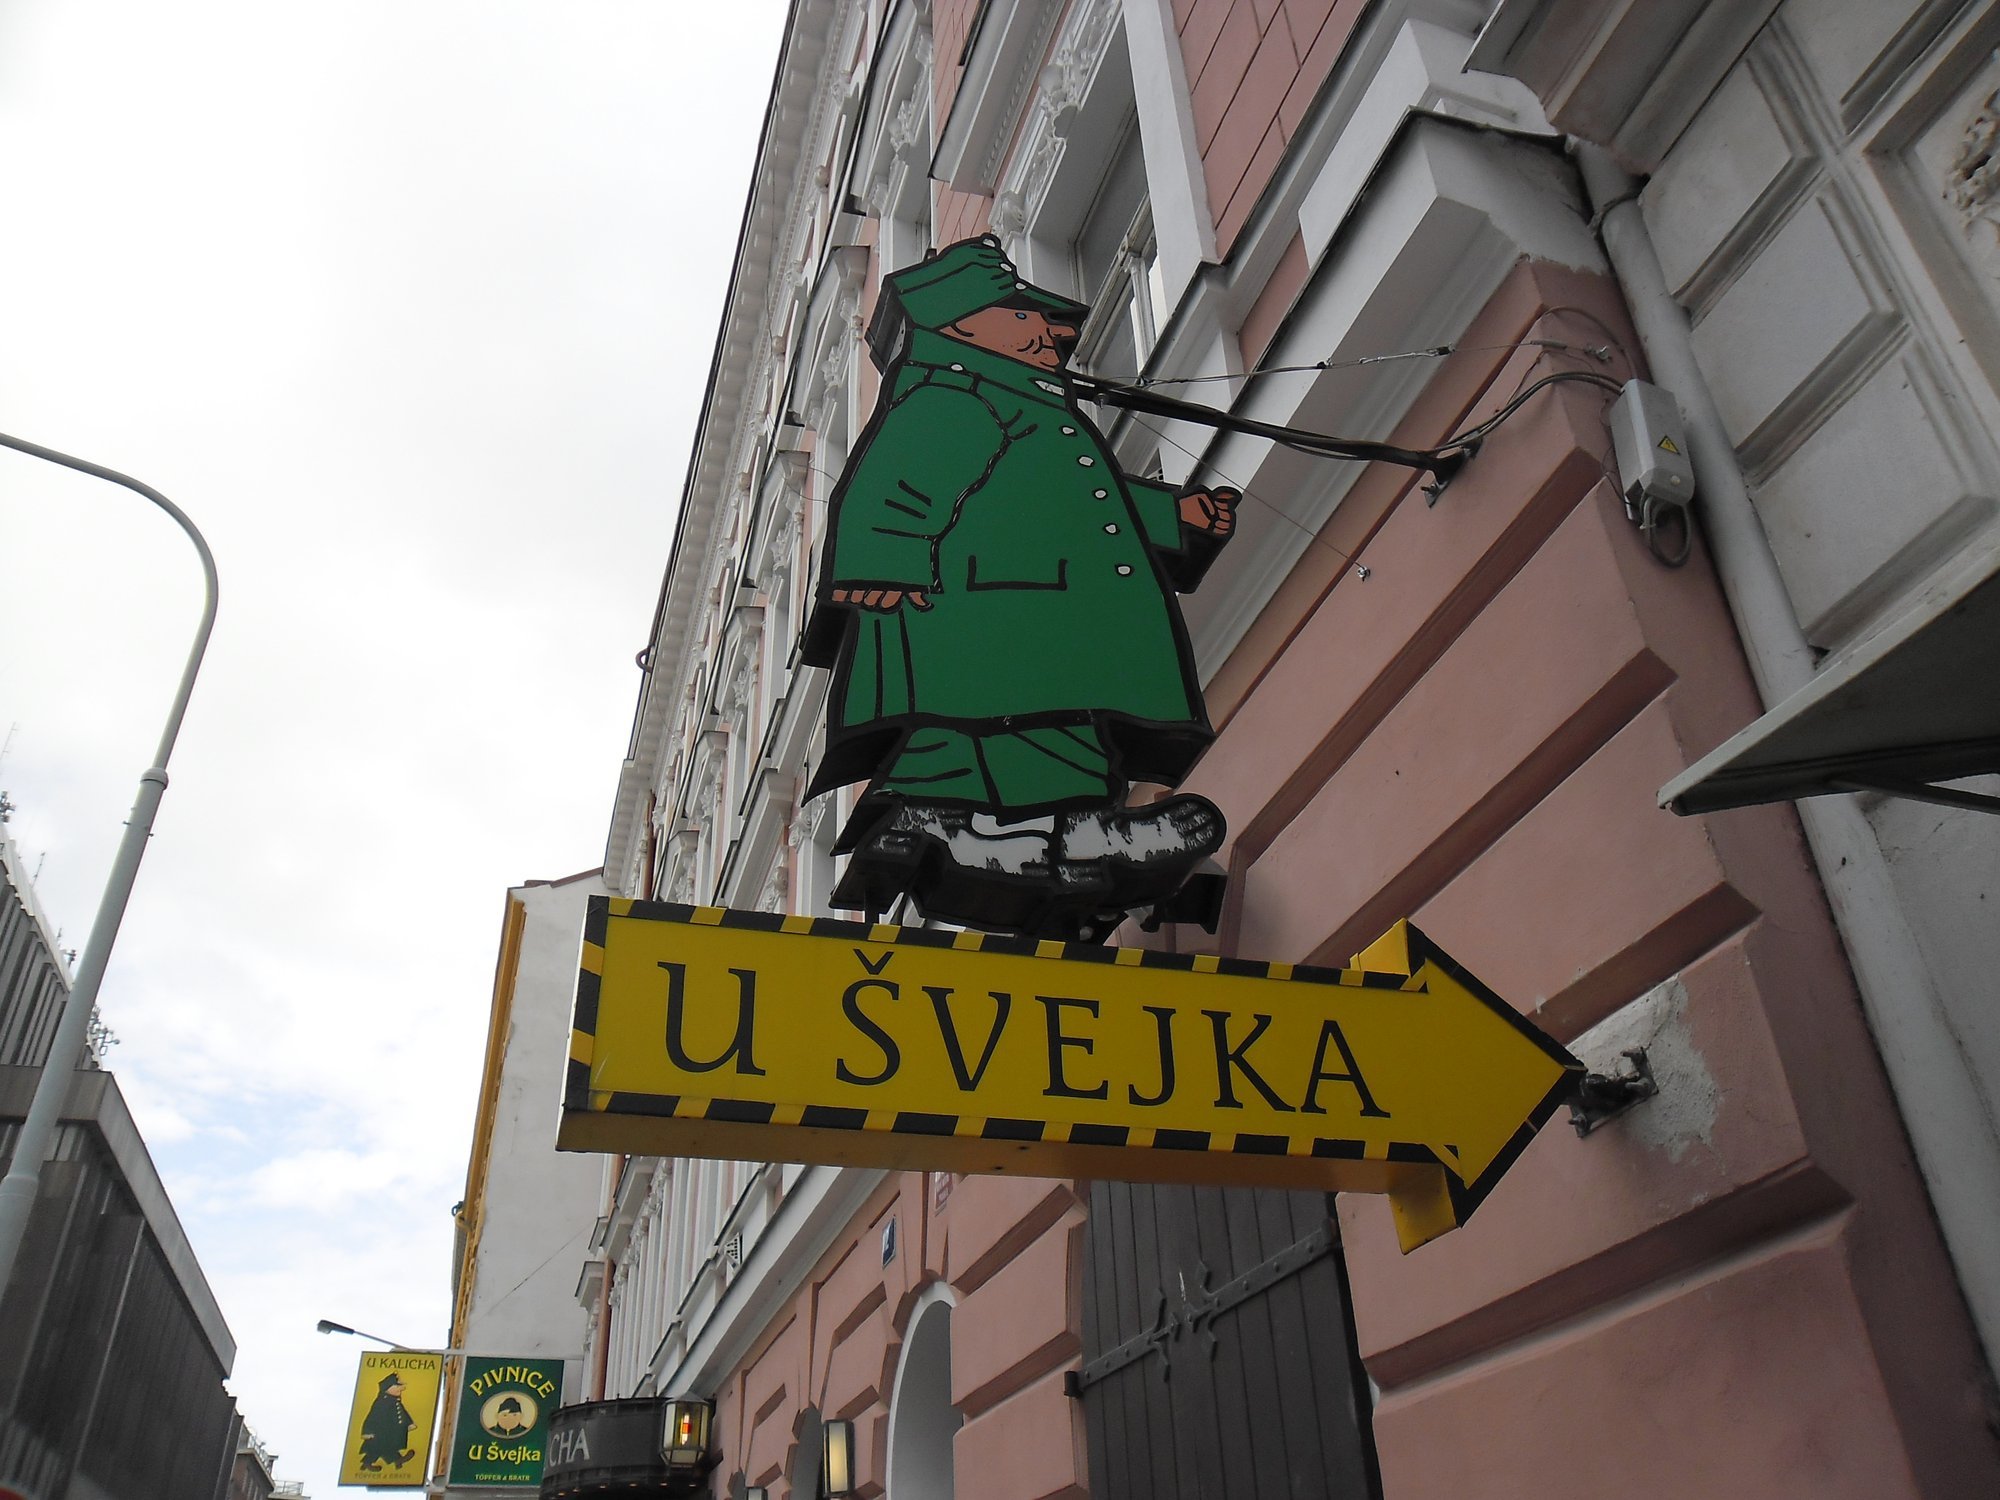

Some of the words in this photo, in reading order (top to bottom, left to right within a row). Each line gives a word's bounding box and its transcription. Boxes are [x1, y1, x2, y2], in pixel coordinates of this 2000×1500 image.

[657, 961, 766, 1077] U
[835, 948, 1392, 1119] ŠVEJKA
[366, 1358, 376, 1368] U
[380, 1358, 436, 1370] KALICHA
[469, 1366, 556, 1399] PIVNICE
[468, 1444, 483, 1460] U
[486, 1441, 541, 1465] Švejka
[547, 1427, 590, 1467] CHA
